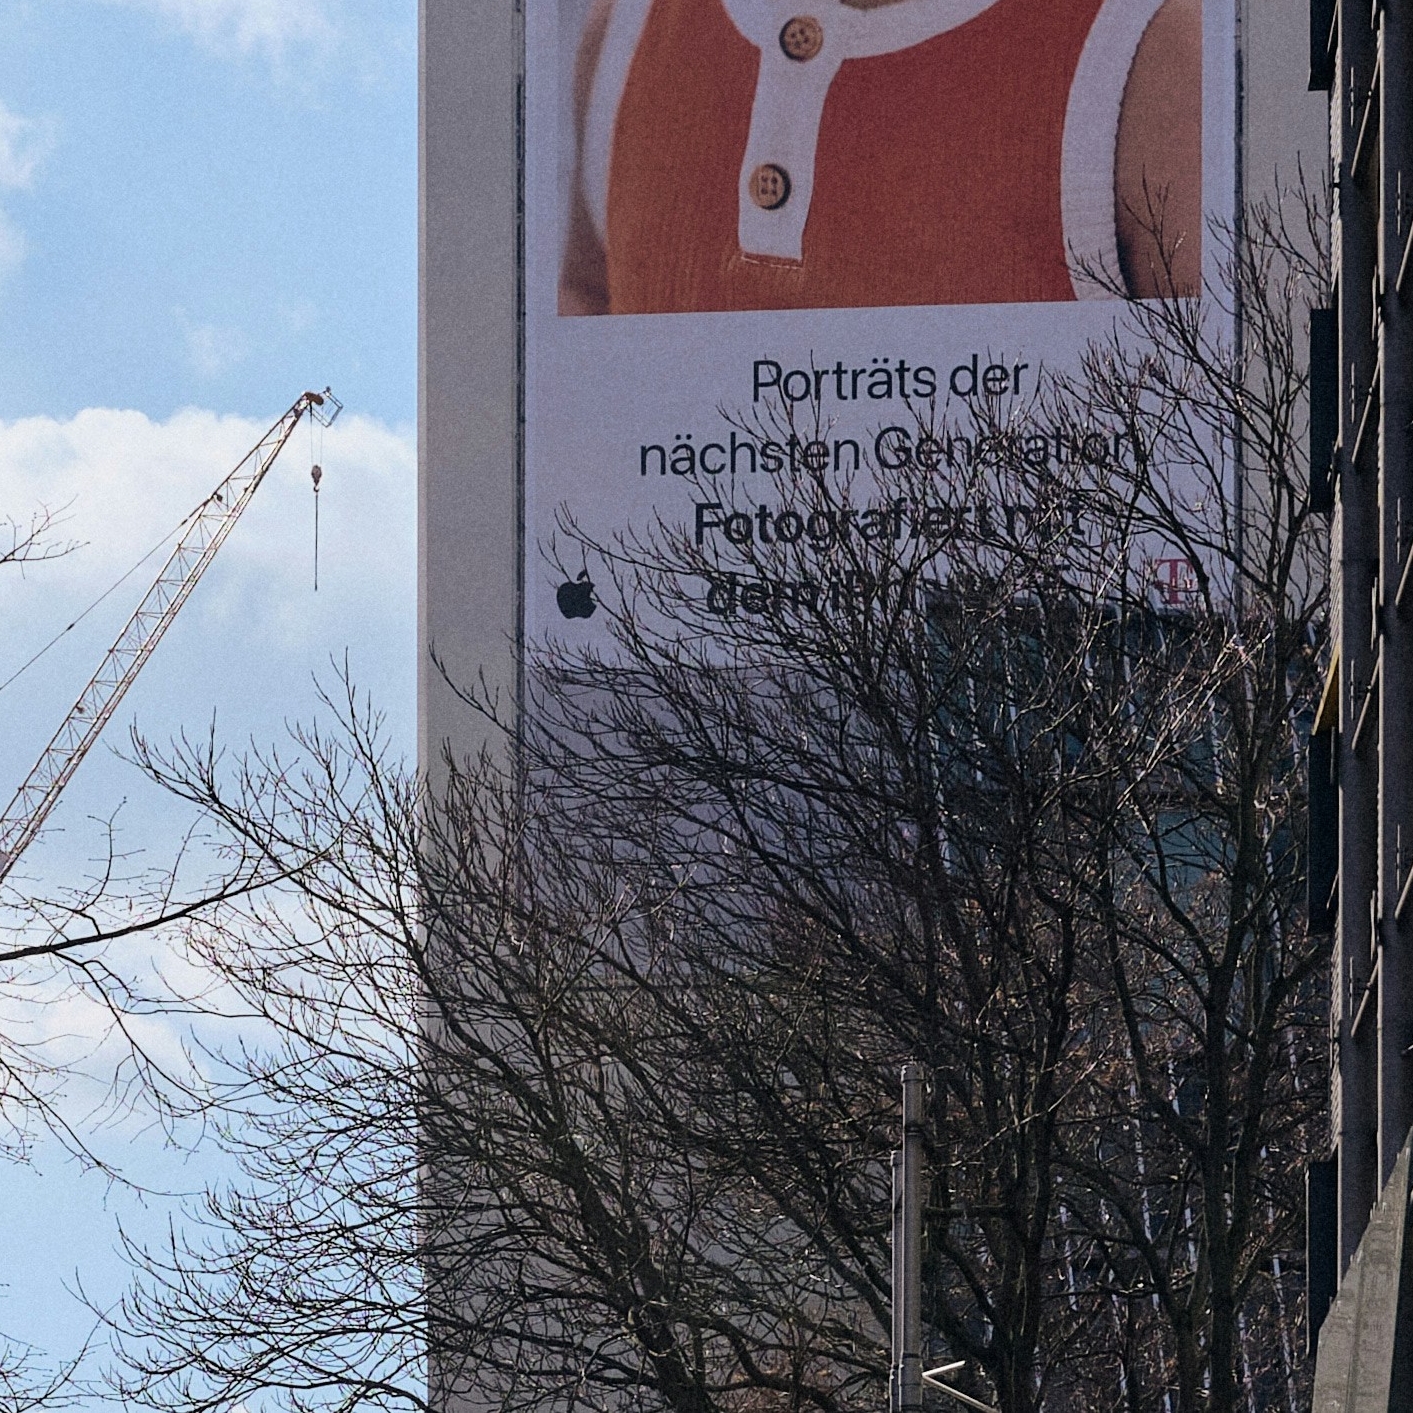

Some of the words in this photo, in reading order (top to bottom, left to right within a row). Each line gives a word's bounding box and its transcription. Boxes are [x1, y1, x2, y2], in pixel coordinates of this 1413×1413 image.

[752, 355, 937, 403] Porträts
[947, 353, 1029, 399] der
[639, 432, 861, 477] nächsten
[1005, 495, 1085, 542] mt
